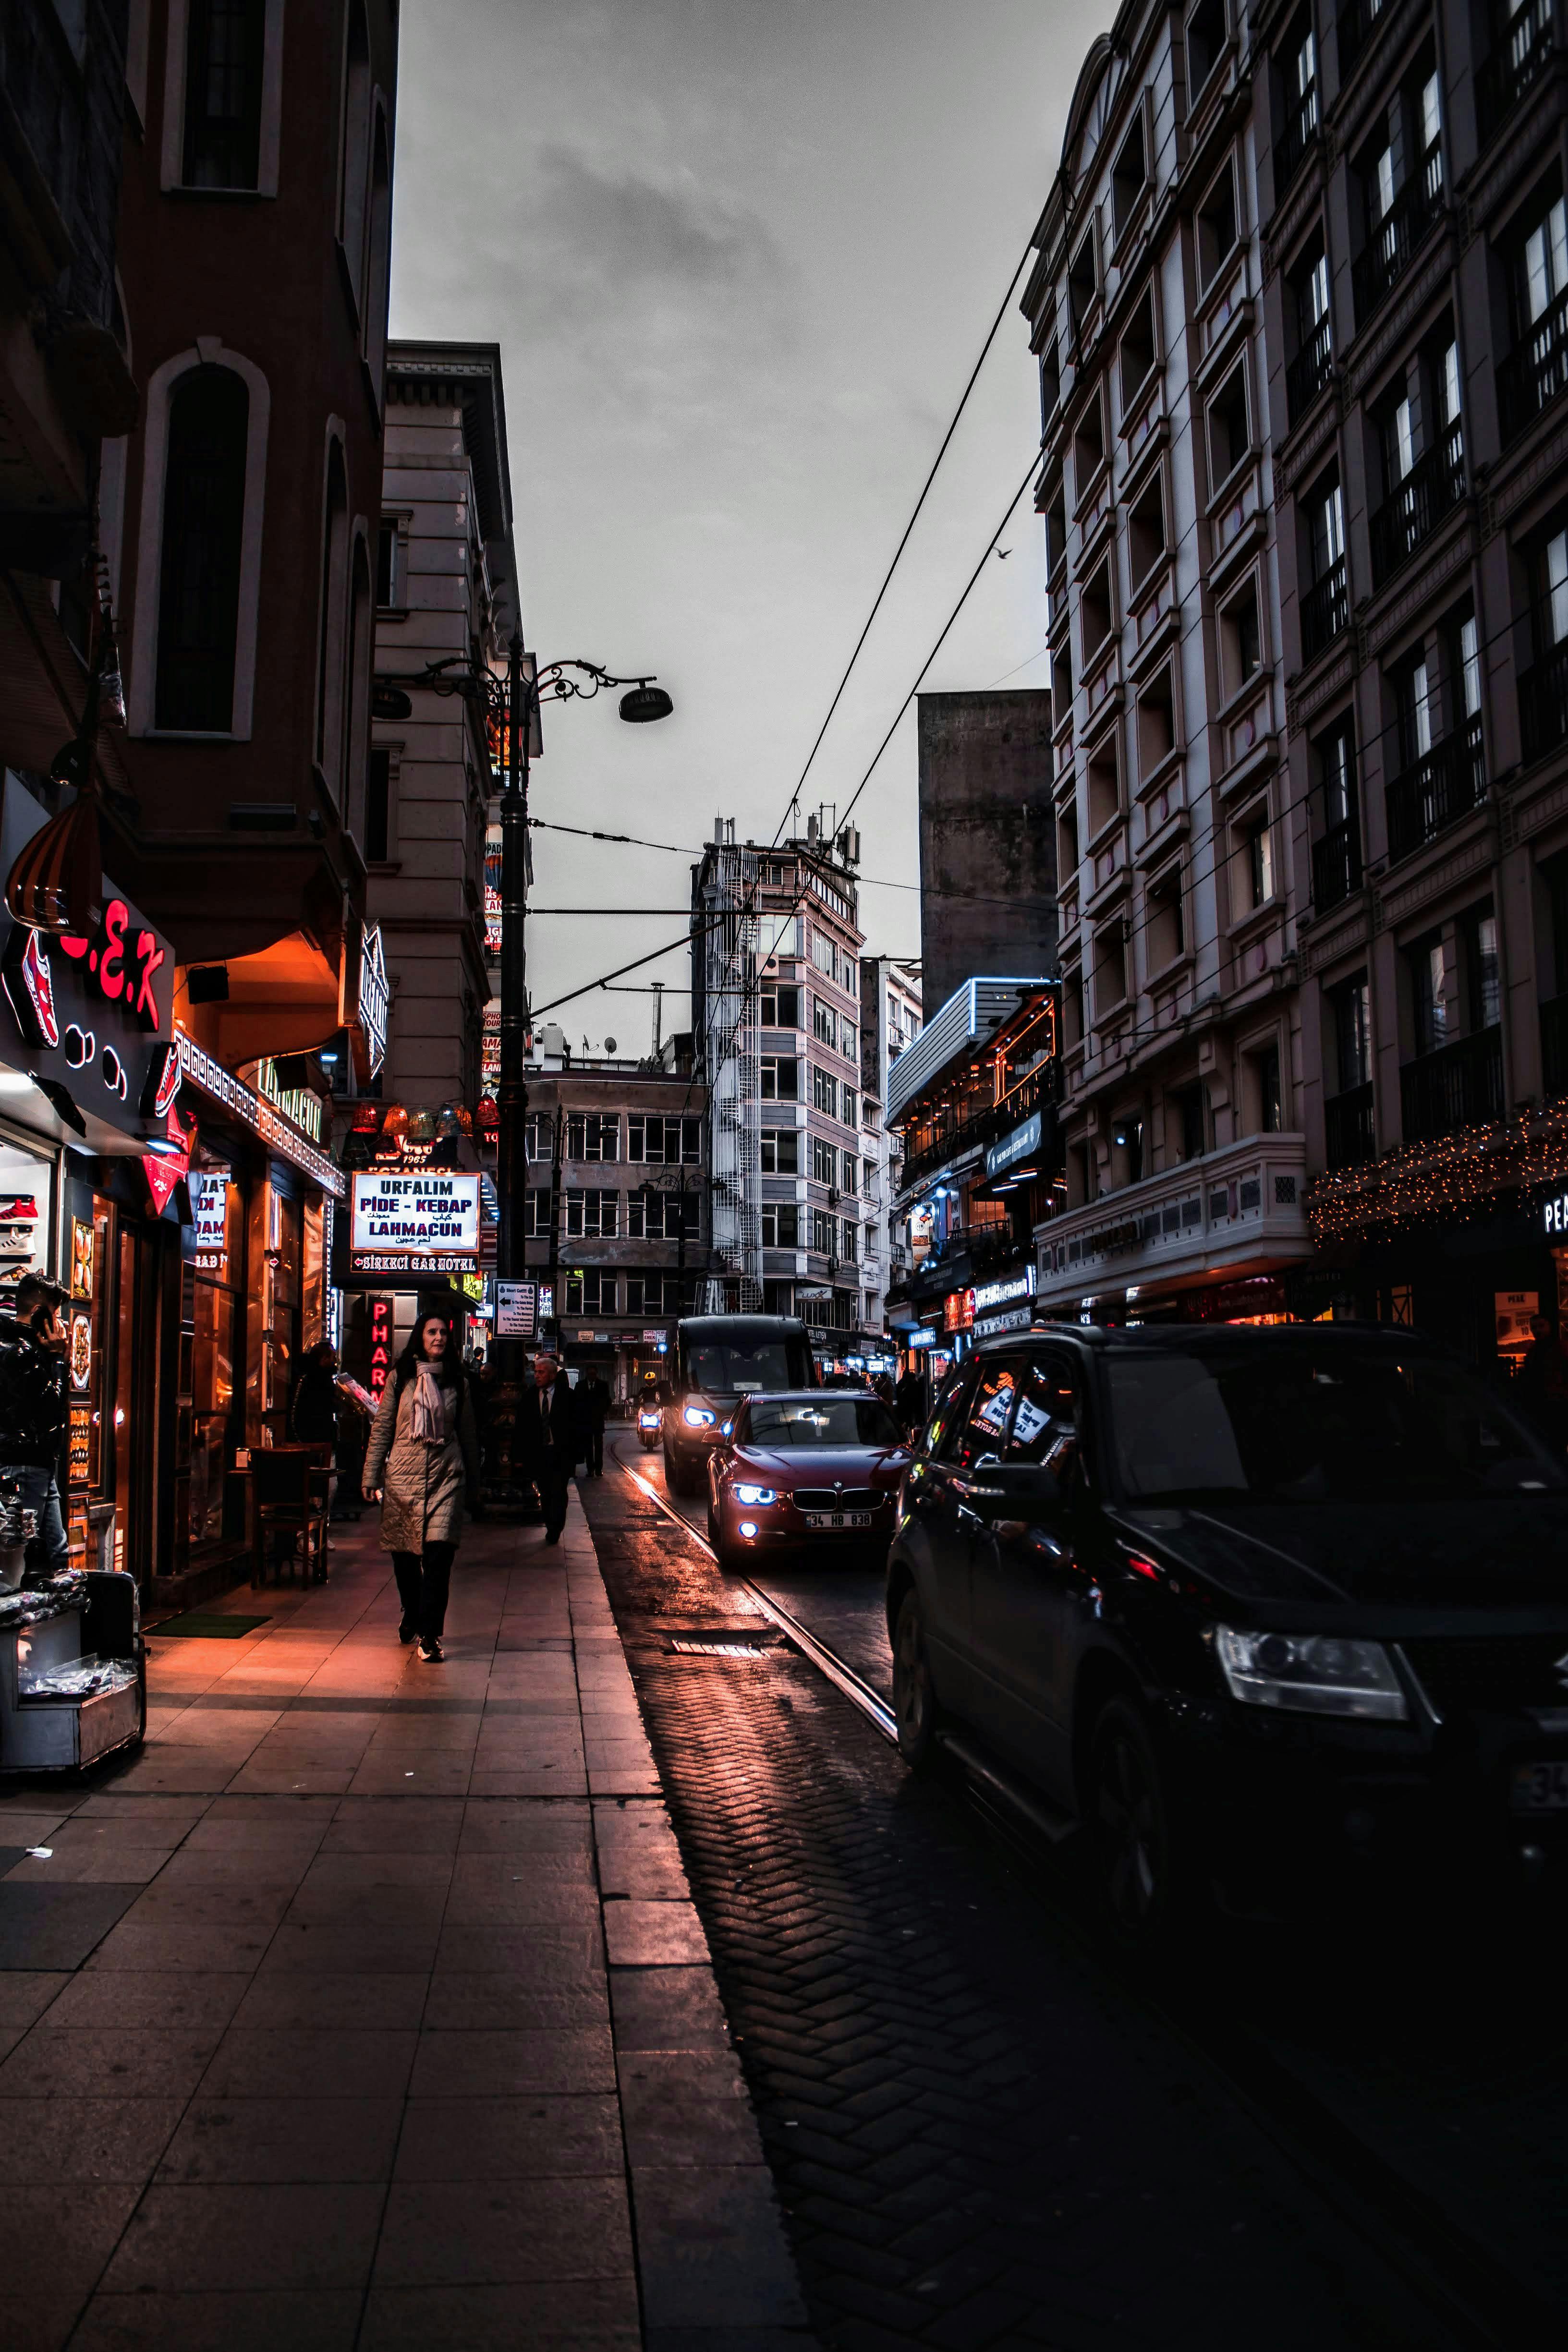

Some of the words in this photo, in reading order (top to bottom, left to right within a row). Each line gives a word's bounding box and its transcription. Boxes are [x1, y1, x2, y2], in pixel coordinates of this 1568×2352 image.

[403, 1155, 427, 1164] 1965
[380, 1180, 452, 1195] URFALIM
[360, 1196, 399, 1212] PİDE
[416, 1199, 472, 1213] KEBAP
[369, 1222, 462, 1237] LAHMACUN
[362, 1255, 408, 1270] SİRKECİ
[411, 1258, 437, 1271] GAR
[438, 1258, 475, 1271] HOTEL
[812, 1515, 824, 1526] 34
[831, 1515, 844, 1526] HB
